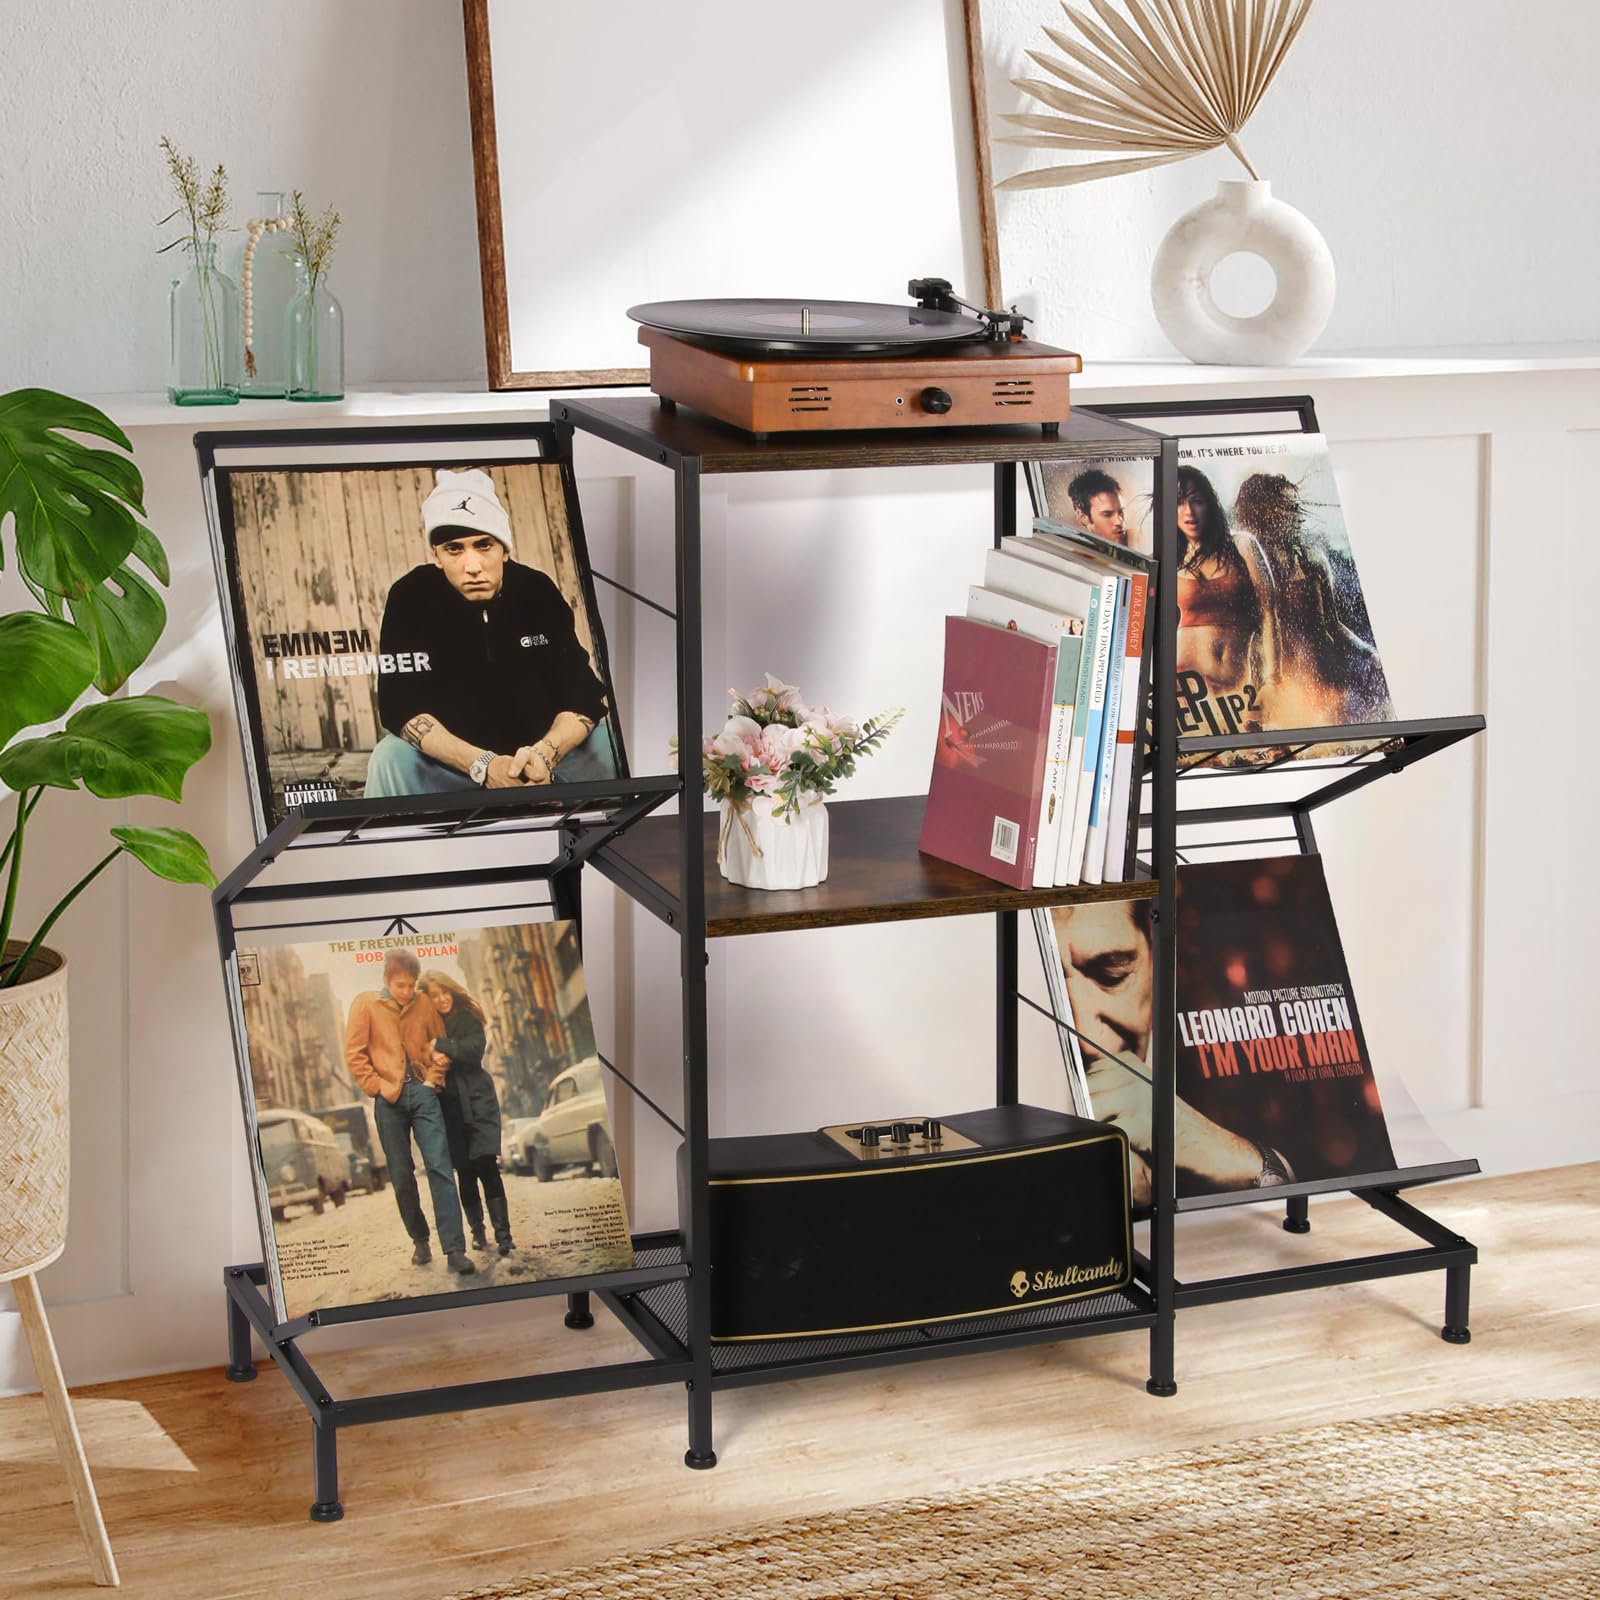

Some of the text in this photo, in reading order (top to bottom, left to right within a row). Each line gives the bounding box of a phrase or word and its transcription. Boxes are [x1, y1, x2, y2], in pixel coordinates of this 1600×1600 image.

[1198, 448, 1213, 458] IT'S
[1215, 447, 1243, 457] WHERE
[1135, 585, 1142, 597] BY
[262, 629, 372, 657] EMINEM
[1094, 584, 1114, 704] ONE DAY DISAPPEARED
[1130, 622, 1140, 651] CAREY
[266, 652, 431, 680] I REMEMBER
[943, 691, 985, 737] NEWS
[288, 790, 334, 805] ADVISORY
[328, 933, 456, 953] THE FREEWHEELIN'
[355, 945, 459, 964] BOB DYLAN
[1244, 983, 1345, 1004] MOTION PICTURE SOUNDTRACK
[1177, 997, 1353, 1047] LEONARD COHEN
[1197, 1029, 1360, 1079] I'M YOUR MAN
[1032, 1257, 1123, 1291] Skullcandy
